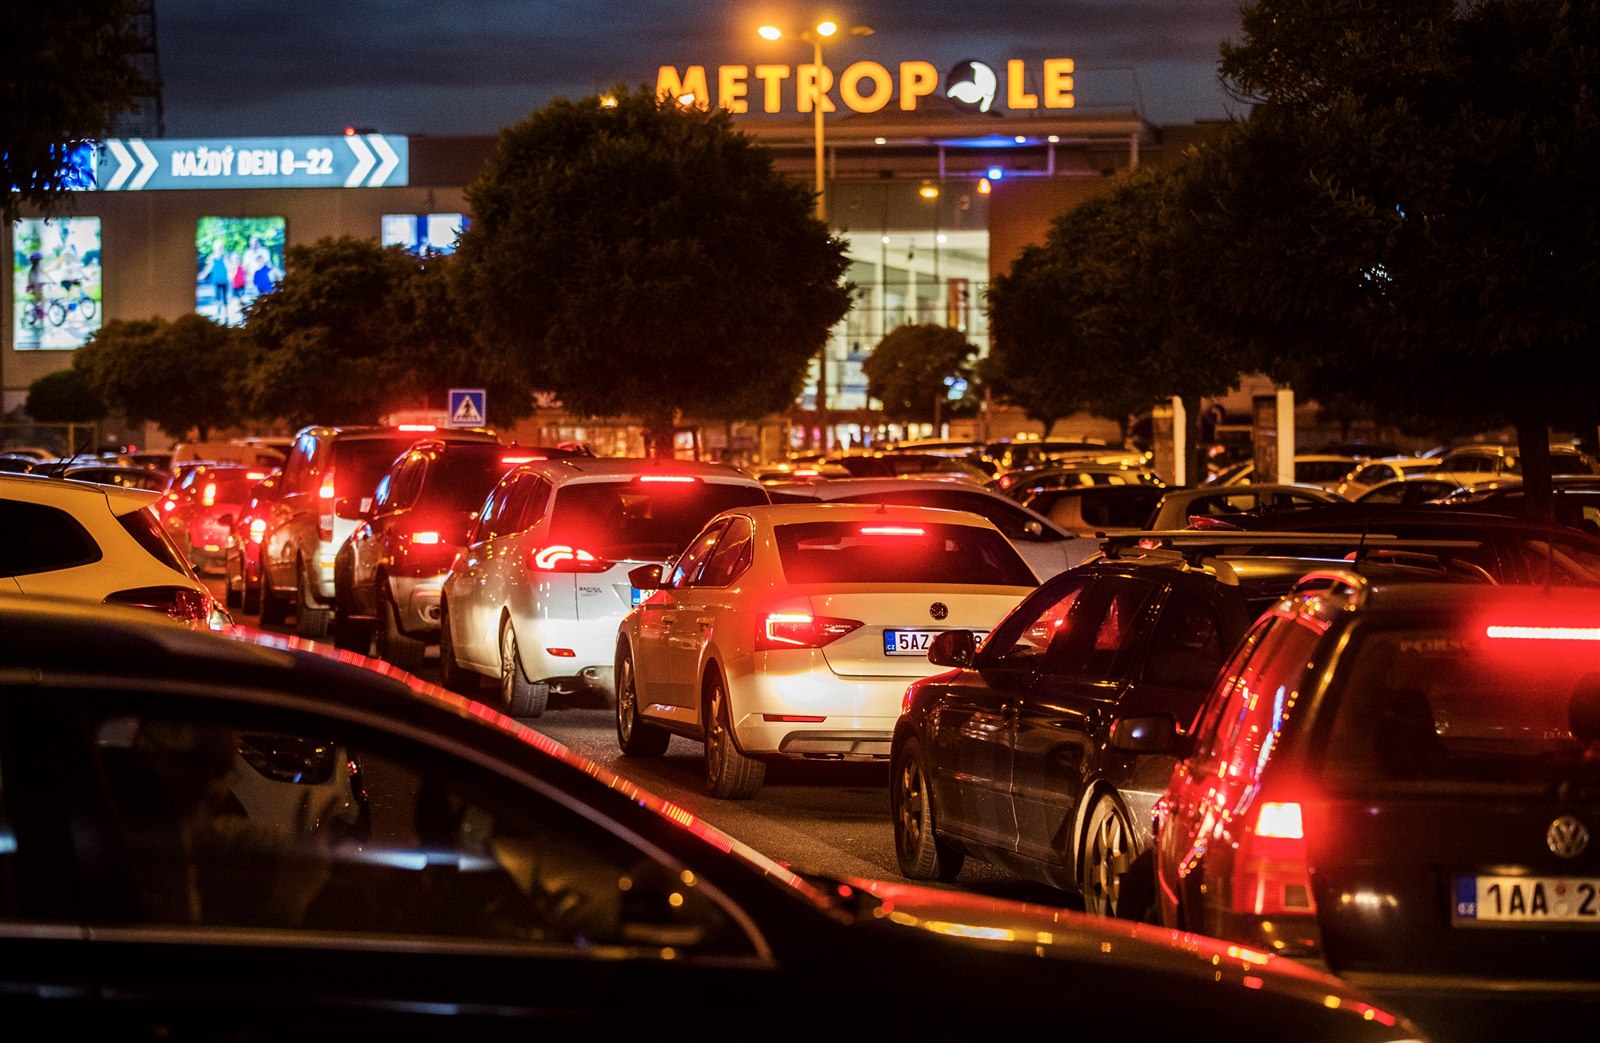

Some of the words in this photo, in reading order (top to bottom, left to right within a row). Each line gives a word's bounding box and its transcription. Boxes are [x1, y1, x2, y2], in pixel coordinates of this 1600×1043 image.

[171, 145, 235, 177] KAŽDÝ
[237, 149, 278, 176] DEN
[899, 633, 930, 650] 5AZ
[1487, 882, 1549, 916] 1AA
[1577, 882, 1600, 916] 2
